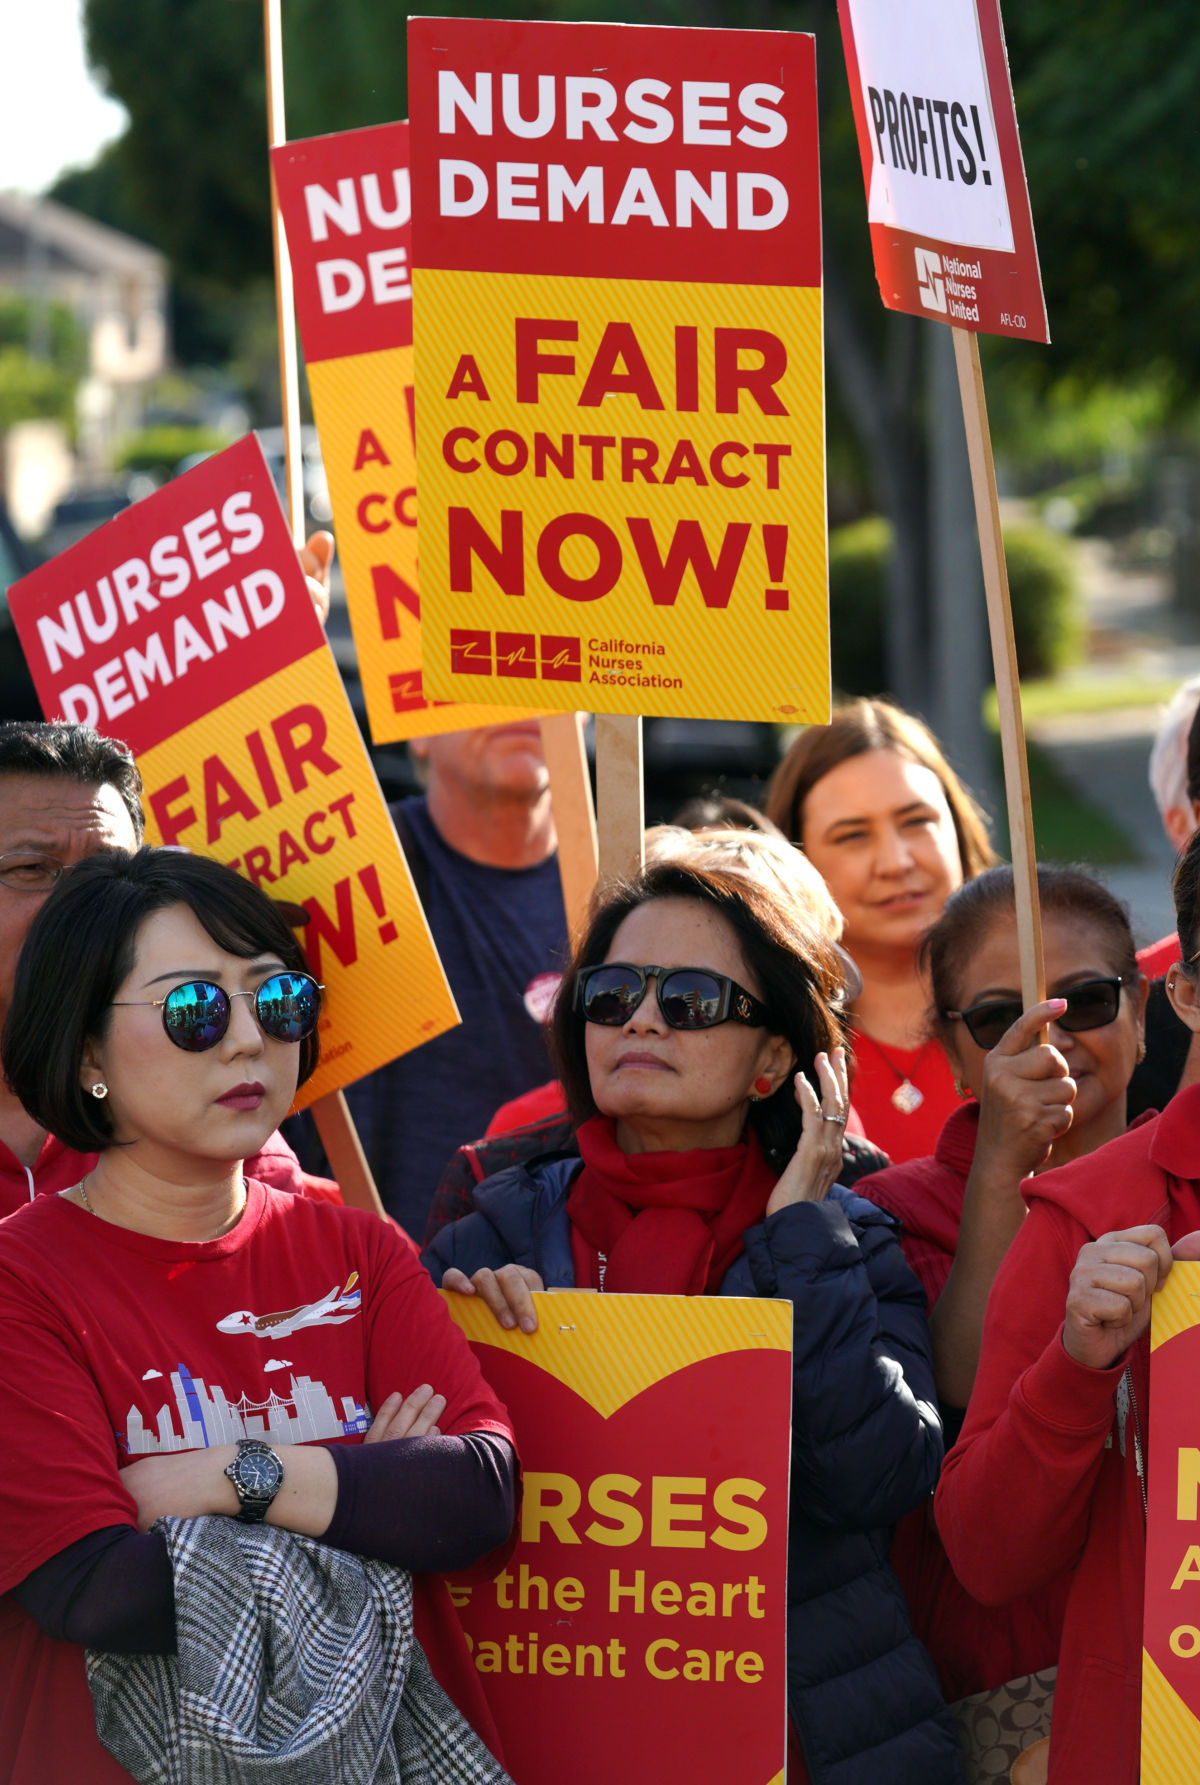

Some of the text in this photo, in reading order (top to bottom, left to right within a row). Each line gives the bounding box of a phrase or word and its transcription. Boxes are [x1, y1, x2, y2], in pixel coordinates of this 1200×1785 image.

[439, 71, 787, 148] NURSES
[869, 87, 991, 185] PROFITS!
[440, 159, 788, 230] DEMAND
[942, 255, 982, 278] National
[946, 276, 977, 299] Nurses
[949, 299, 979, 321] United
[1001, 313, 1026, 329] AFL-CIO
[446, 318, 789, 416] A FAIR
[354, 430, 390, 470] A
[443, 427, 791, 489] CONTRACT
[38, 492, 263, 672] NURSES
[448, 507, 789, 611] NOW!
[59, 569, 285, 734] DEMAND
[589, 639, 665, 655] California
[589, 655, 642, 670] Nurses
[590, 672, 682, 688] Association
[149, 705, 341, 846] FAIR
[522, 1473, 768, 1551] RSES
[496, 1565, 584, 1611] the
[610, 1569, 765, 1618] Heart
[645, 1639, 764, 1683] Care
